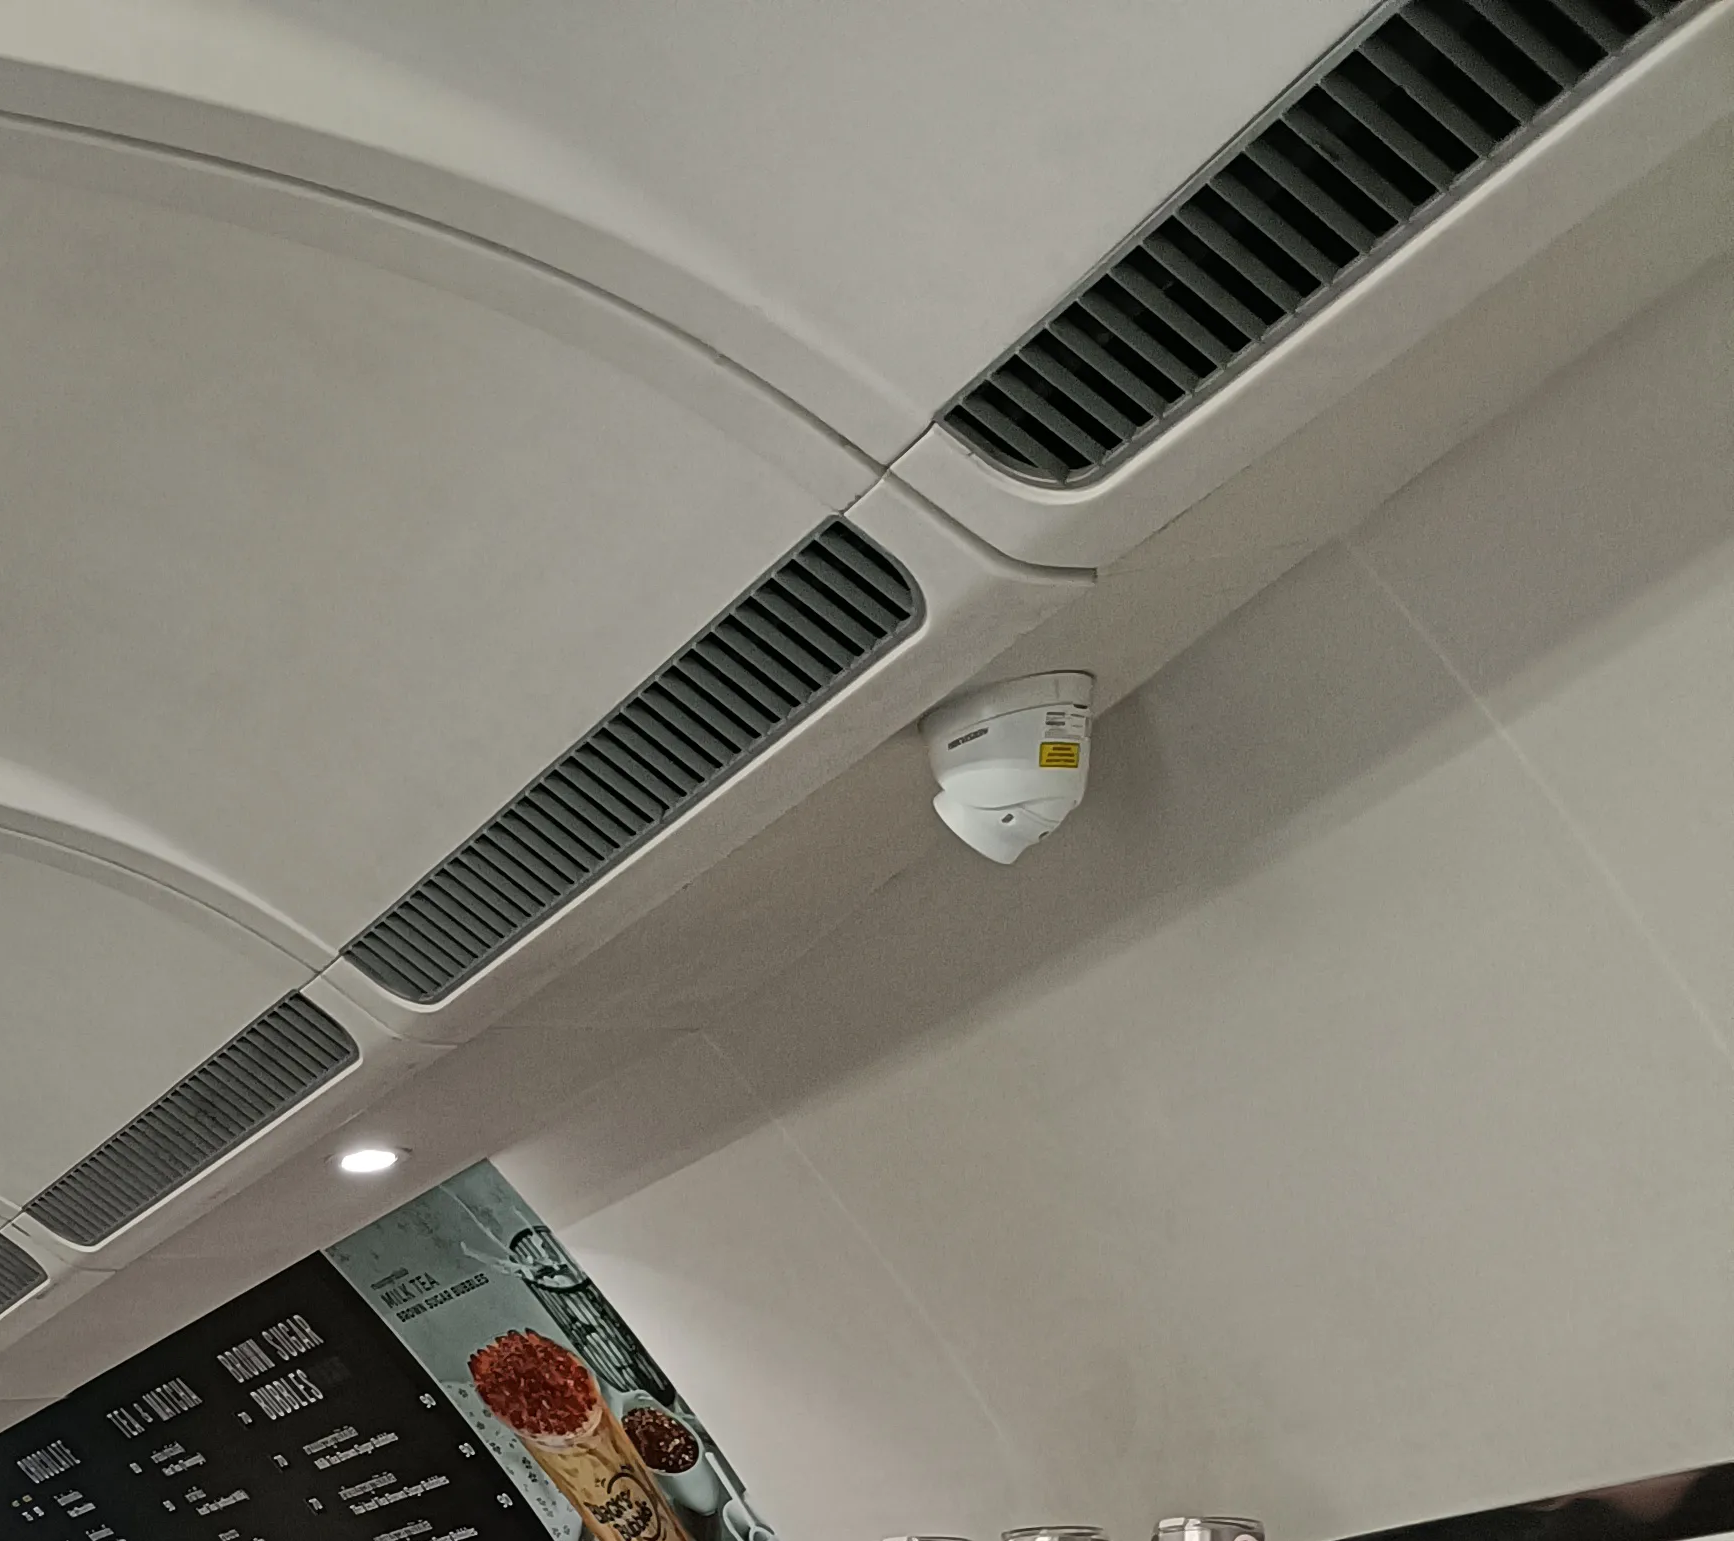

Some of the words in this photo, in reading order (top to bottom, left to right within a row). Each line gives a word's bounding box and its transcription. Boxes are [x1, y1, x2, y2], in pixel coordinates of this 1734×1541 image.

[380, 1283, 416, 1308] MILK
[409, 1272, 440, 1294] TEA
[217, 1339, 275, 1383] BROWN
[262, 1315, 324, 1360] SUGAR
[133, 1403, 153, 1422] &
[142, 1378, 202, 1421] MATCHA
[250, 1369, 323, 1420] BUBBLES
[107, 1408, 145, 1438] TEA
